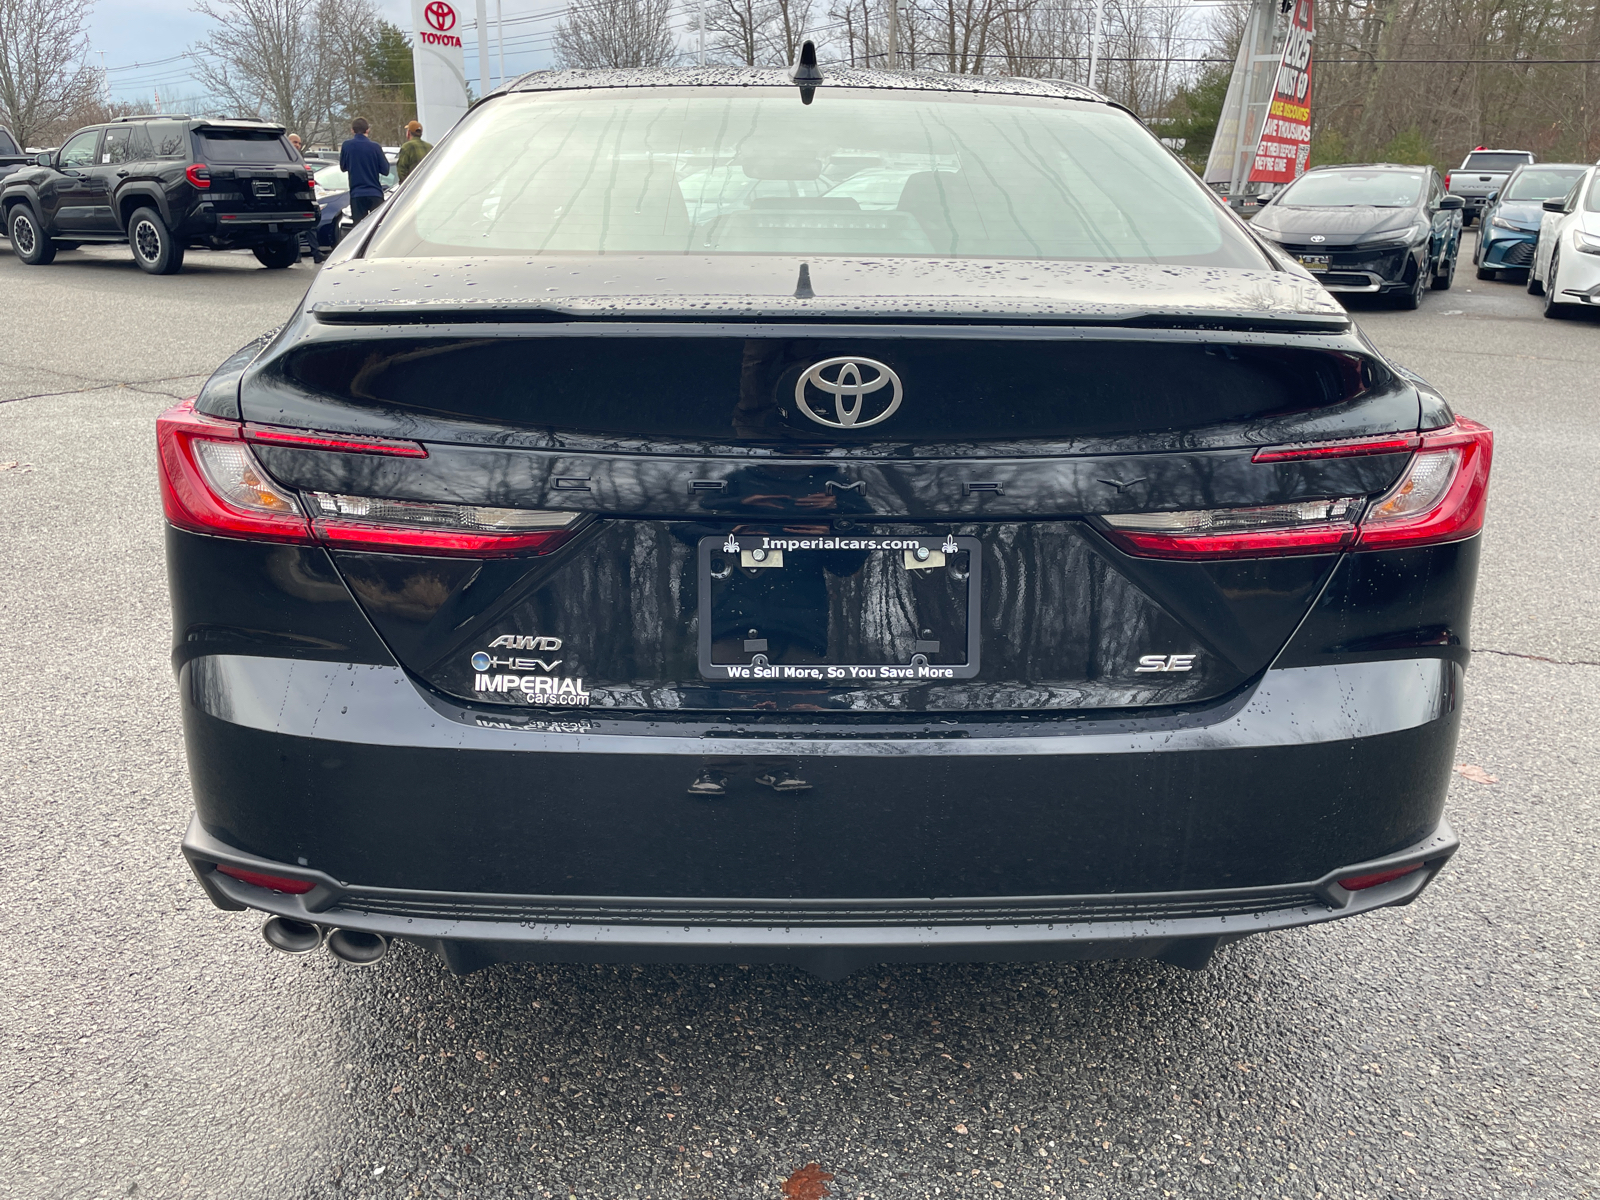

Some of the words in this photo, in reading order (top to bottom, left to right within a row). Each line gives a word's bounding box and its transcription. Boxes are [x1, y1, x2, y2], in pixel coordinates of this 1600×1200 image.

[420, 31, 462, 48] TOYOTA
[1285, 23, 1316, 70] 2025
[1277, 65, 1299, 96] MUST
[1297, 72, 1309, 99] GO
[1264, 118, 1278, 136] AVE
[1278, 120, 1311, 142] THOUSANDS
[551, 476, 1147, 497] CAMRY
[762, 537, 920, 551] Imperialcars.com
[488, 634, 563, 651] AWD
[1135, 654, 1197, 672] SE
[727, 667, 750, 678] We
[753, 667, 780, 678] Sell
[784, 667, 823, 680] More,
[827, 667, 846, 678] So
[850, 667, 876, 678] You
[880, 667, 915, 678] Save
[918, 667, 953, 678] More
[474, 673, 590, 696] IMPERIAL
[526, 693, 590, 705] cars.com
